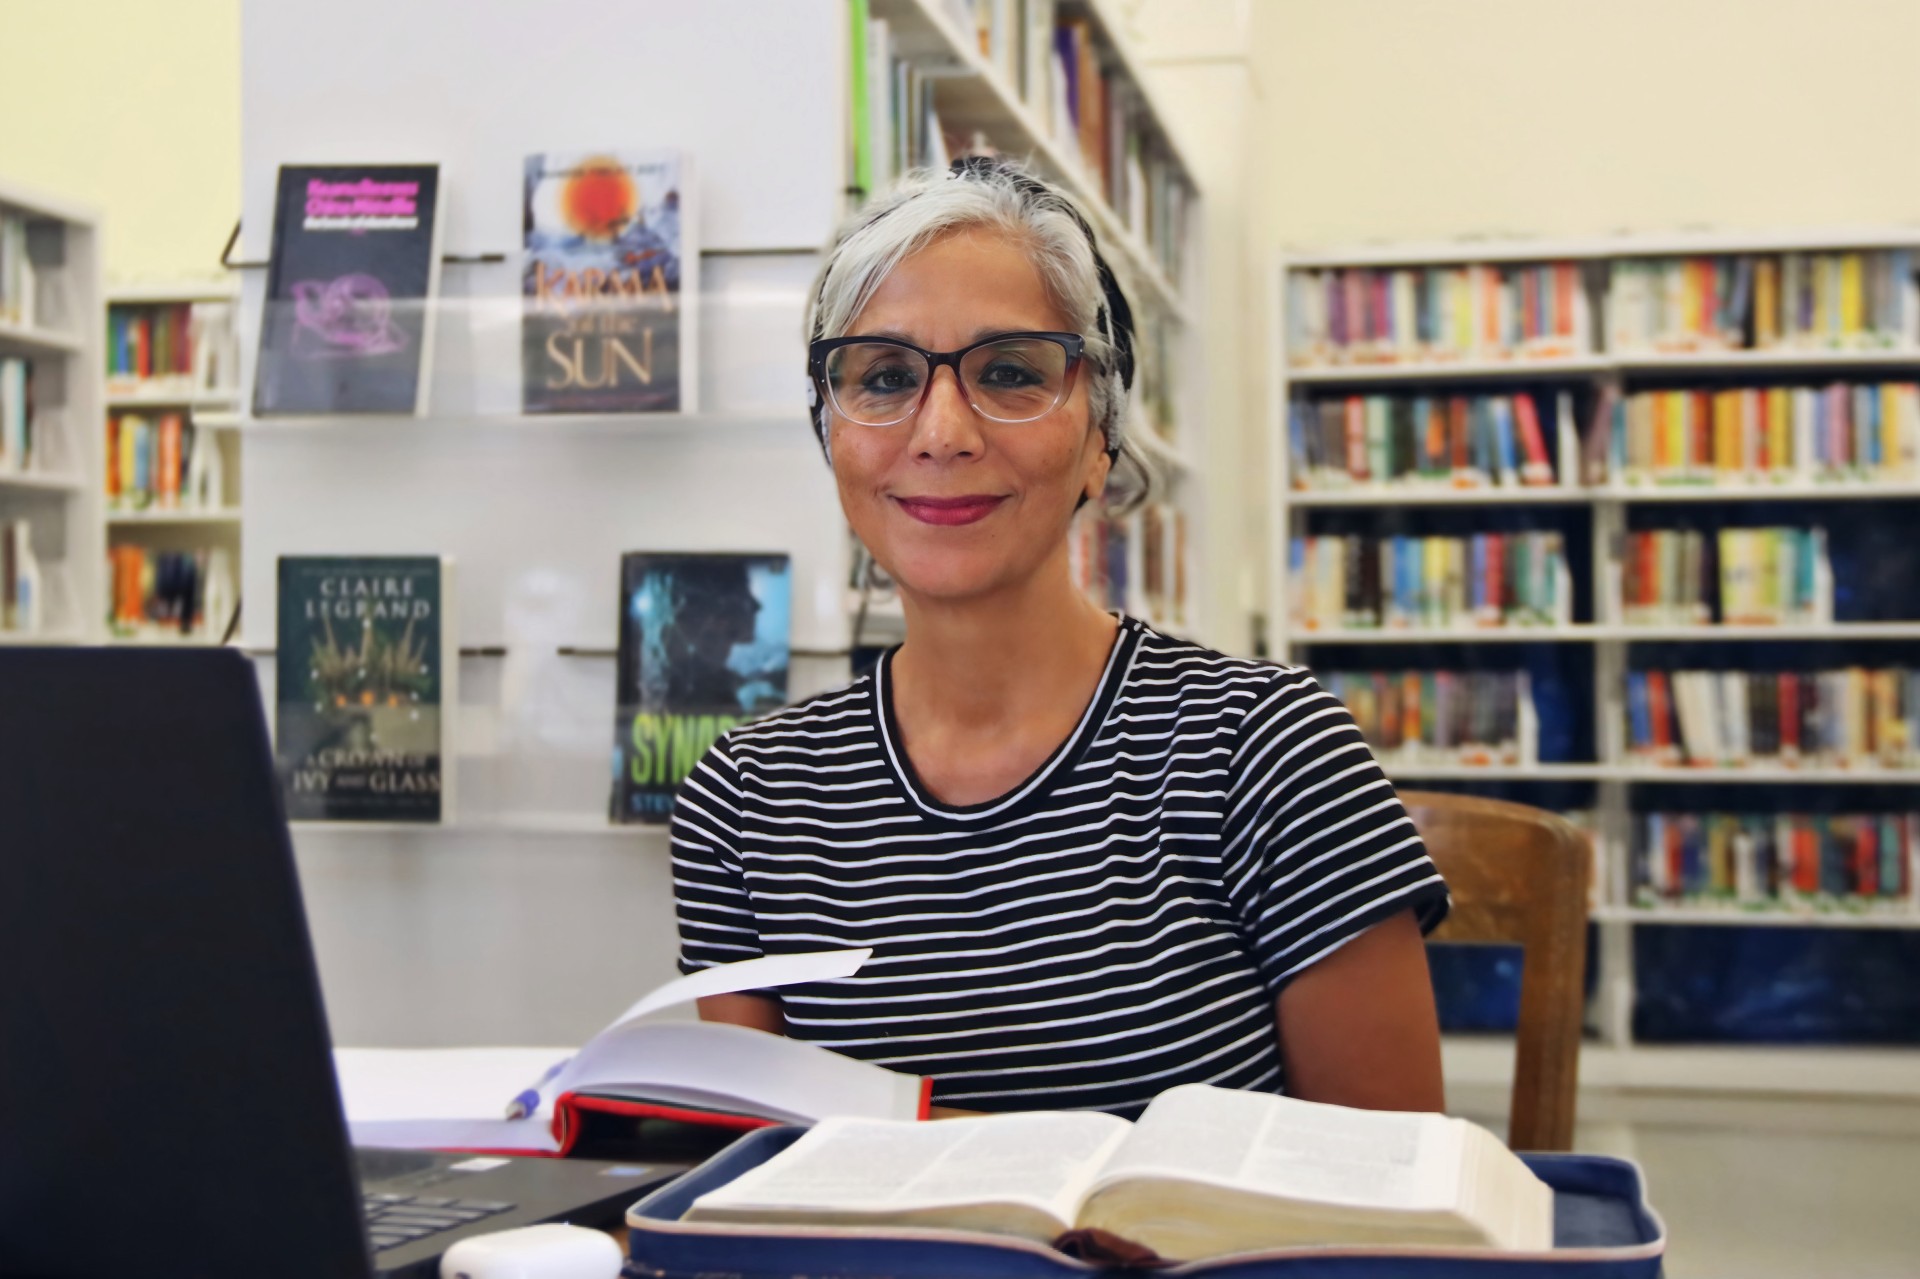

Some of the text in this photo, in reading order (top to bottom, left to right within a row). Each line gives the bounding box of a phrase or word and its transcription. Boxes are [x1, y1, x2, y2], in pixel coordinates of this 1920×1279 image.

[535, 260, 674, 316] KARMA
[545, 326, 654, 389] SUN
[320, 577, 413, 598] CLAIRE
